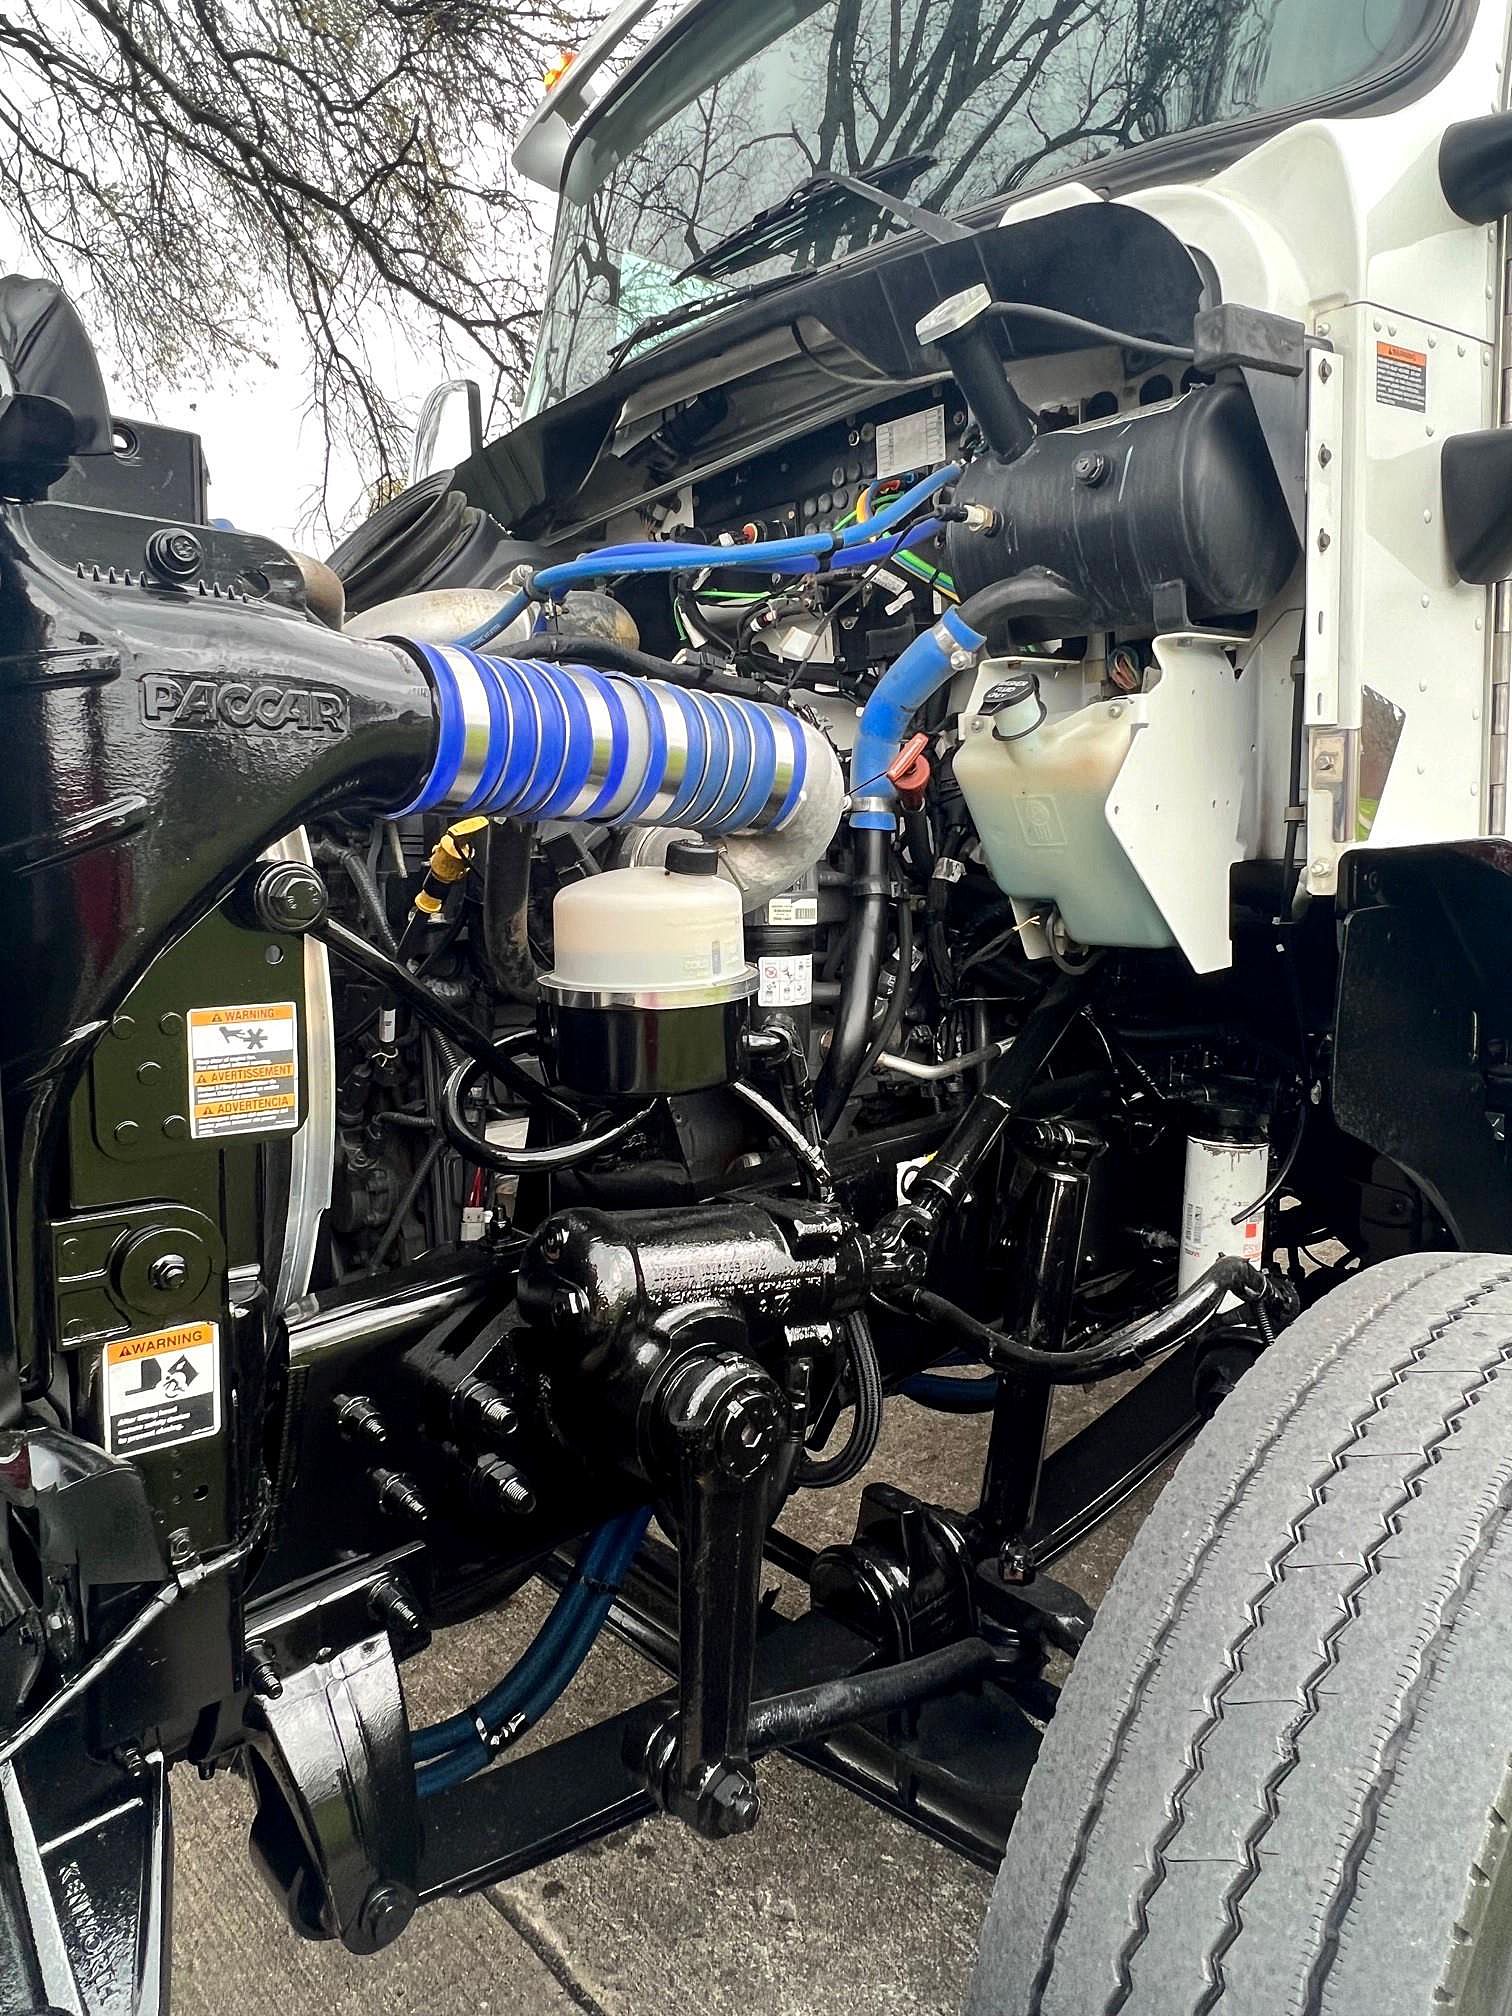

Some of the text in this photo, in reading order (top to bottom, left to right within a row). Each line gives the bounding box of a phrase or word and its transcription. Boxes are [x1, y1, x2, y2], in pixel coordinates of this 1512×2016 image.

[143, 677, 345, 733] PACCAR
[224, 1008, 275, 1021] WARNING
[211, 1065, 292, 1082] AVERTISSEMENT
[217, 1096, 289, 1113] ADVERTENCIA
[131, 1331, 203, 1355] WARNING
[58, 1861, 121, 2007] KENWORTH
